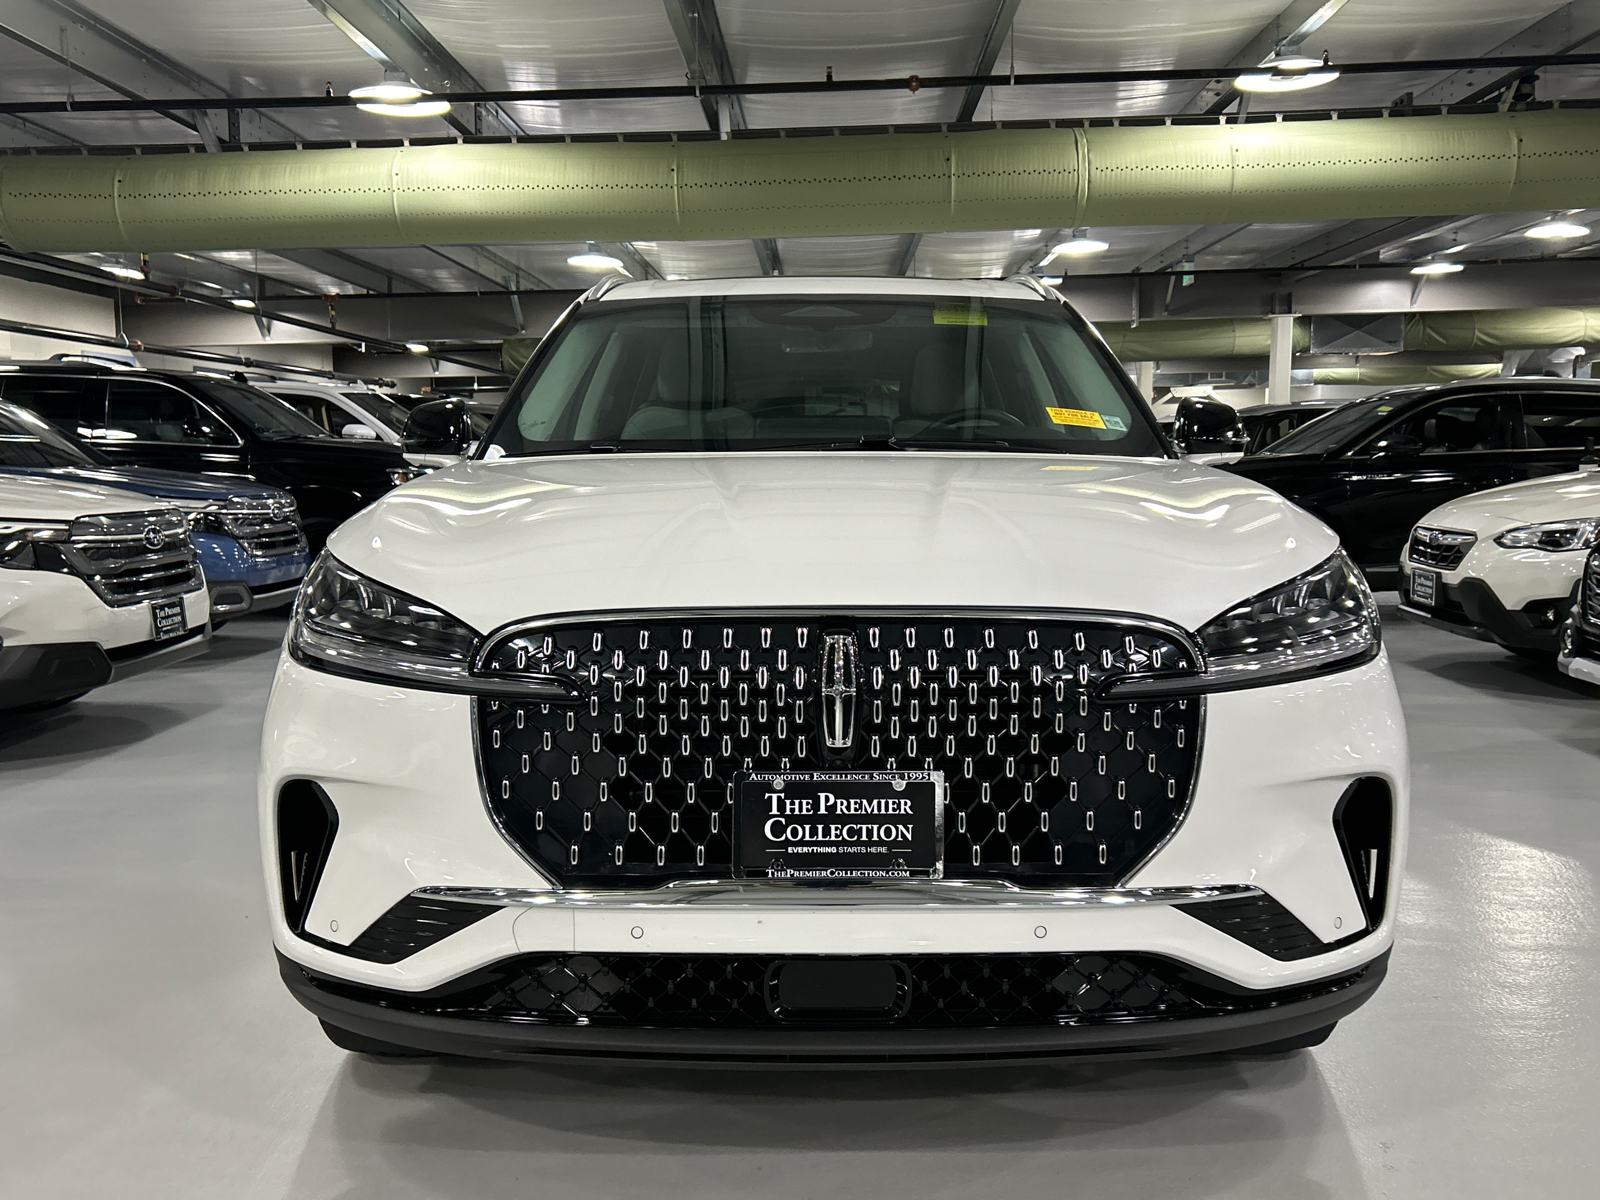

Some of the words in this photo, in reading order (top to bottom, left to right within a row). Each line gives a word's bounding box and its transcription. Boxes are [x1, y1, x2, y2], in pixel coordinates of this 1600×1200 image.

[749, 772, 811, 781] AUTOMOTIVE
[812, 772, 871, 781] EXCELLENCE
[872, 772, 900, 781] SINCE
[903, 772, 930, 781] 1995
[764, 792, 814, 815] THE
[817, 792, 914, 815] PREMIER
[764, 817, 914, 842] COLLECTION
[787, 846, 837, 854] EVERYTHING
[838, 846, 867, 854] STARTS
[766, 868, 911, 878] THEPREMIERCOLLECTION.COM
